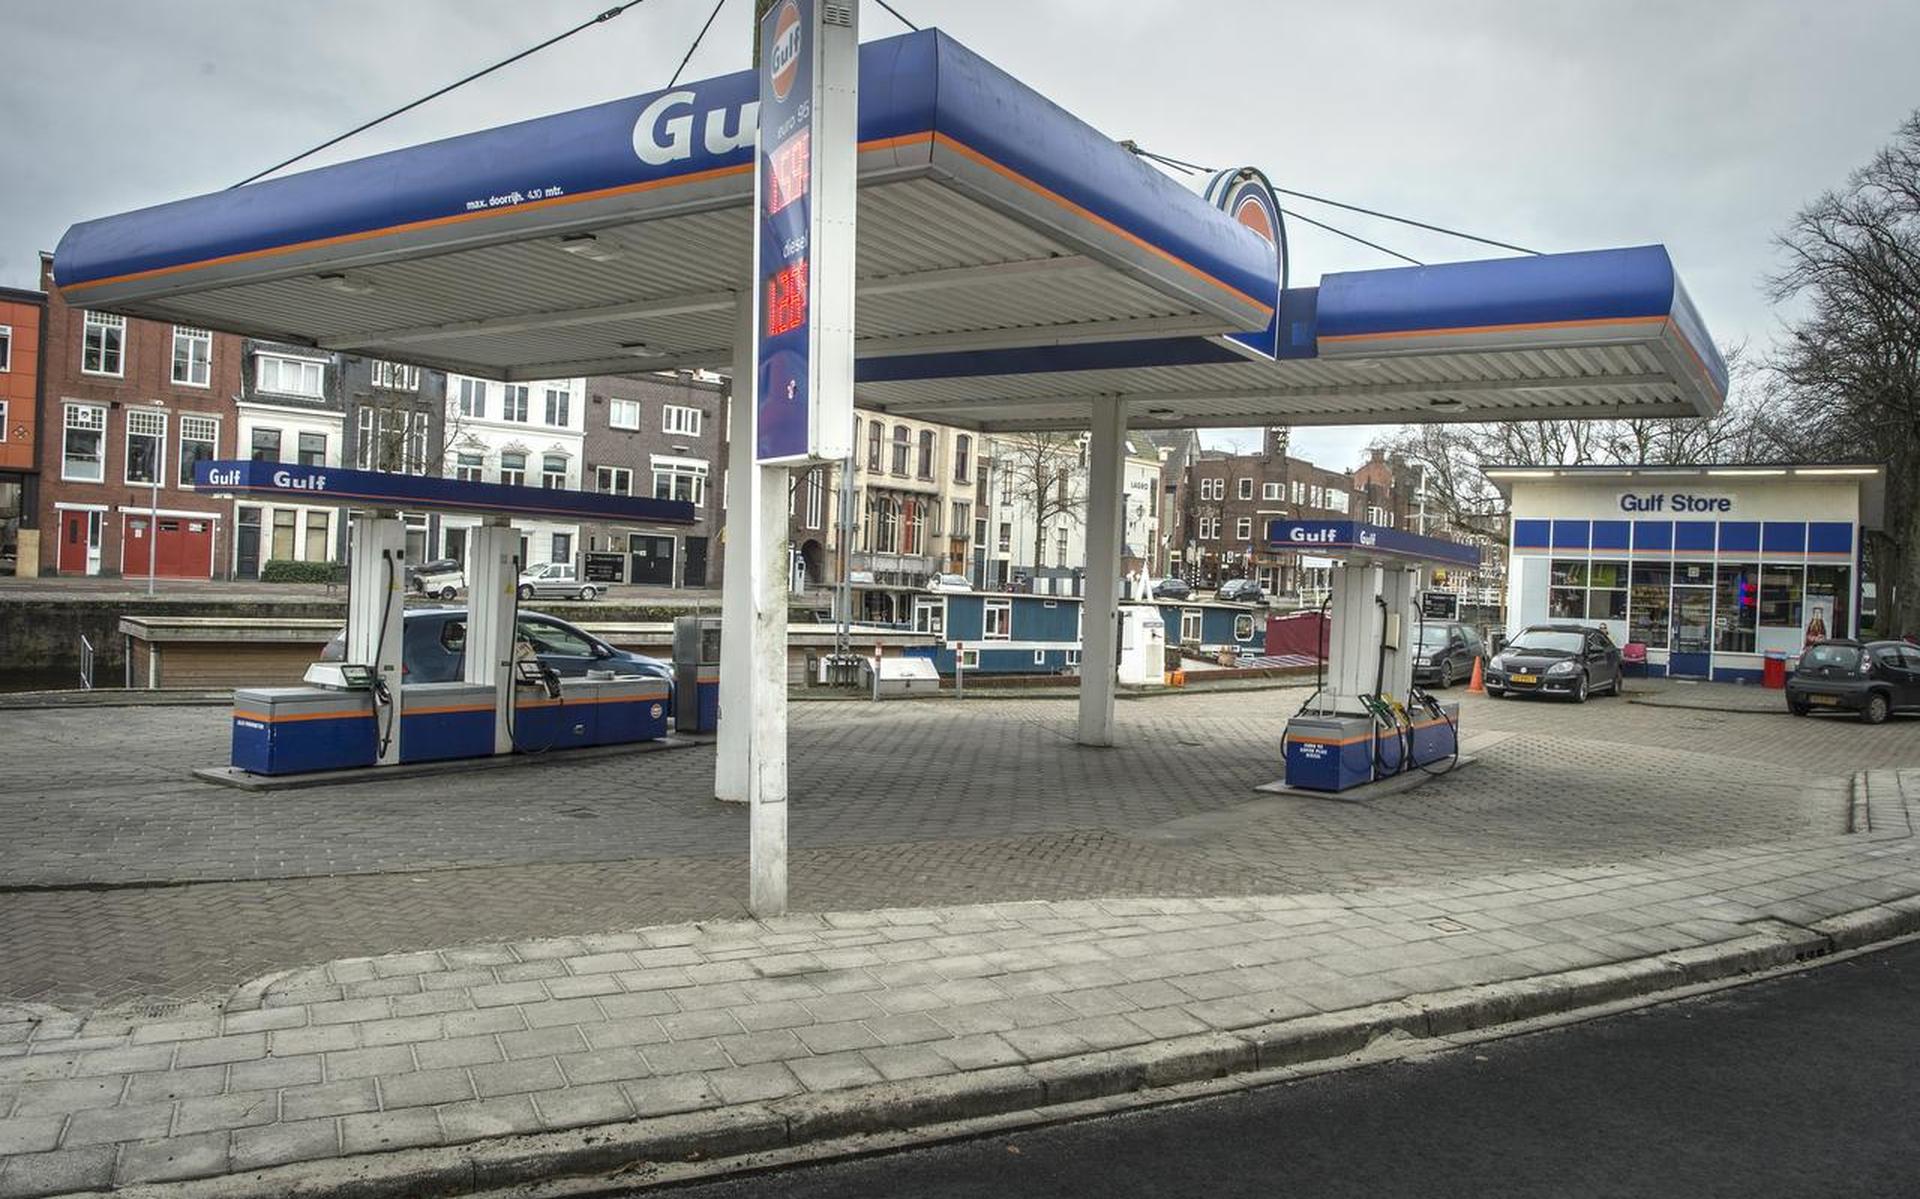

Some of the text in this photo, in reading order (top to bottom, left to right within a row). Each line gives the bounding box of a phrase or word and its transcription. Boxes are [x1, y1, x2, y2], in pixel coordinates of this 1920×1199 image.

[773, 25, 800, 74] Gulf
[632, 91, 760, 166] Gu
[466, 199, 488, 210] max.
[545, 185, 564, 197] mtr.
[783, 228, 808, 258] diesel
[209, 468, 241, 486] Gulf
[273, 470, 327, 490] Gulf
[1620, 493, 1731, 512] Gulf Store
[1289, 526, 1337, 543] Gulf
[1360, 530, 1377, 546] Gulf
